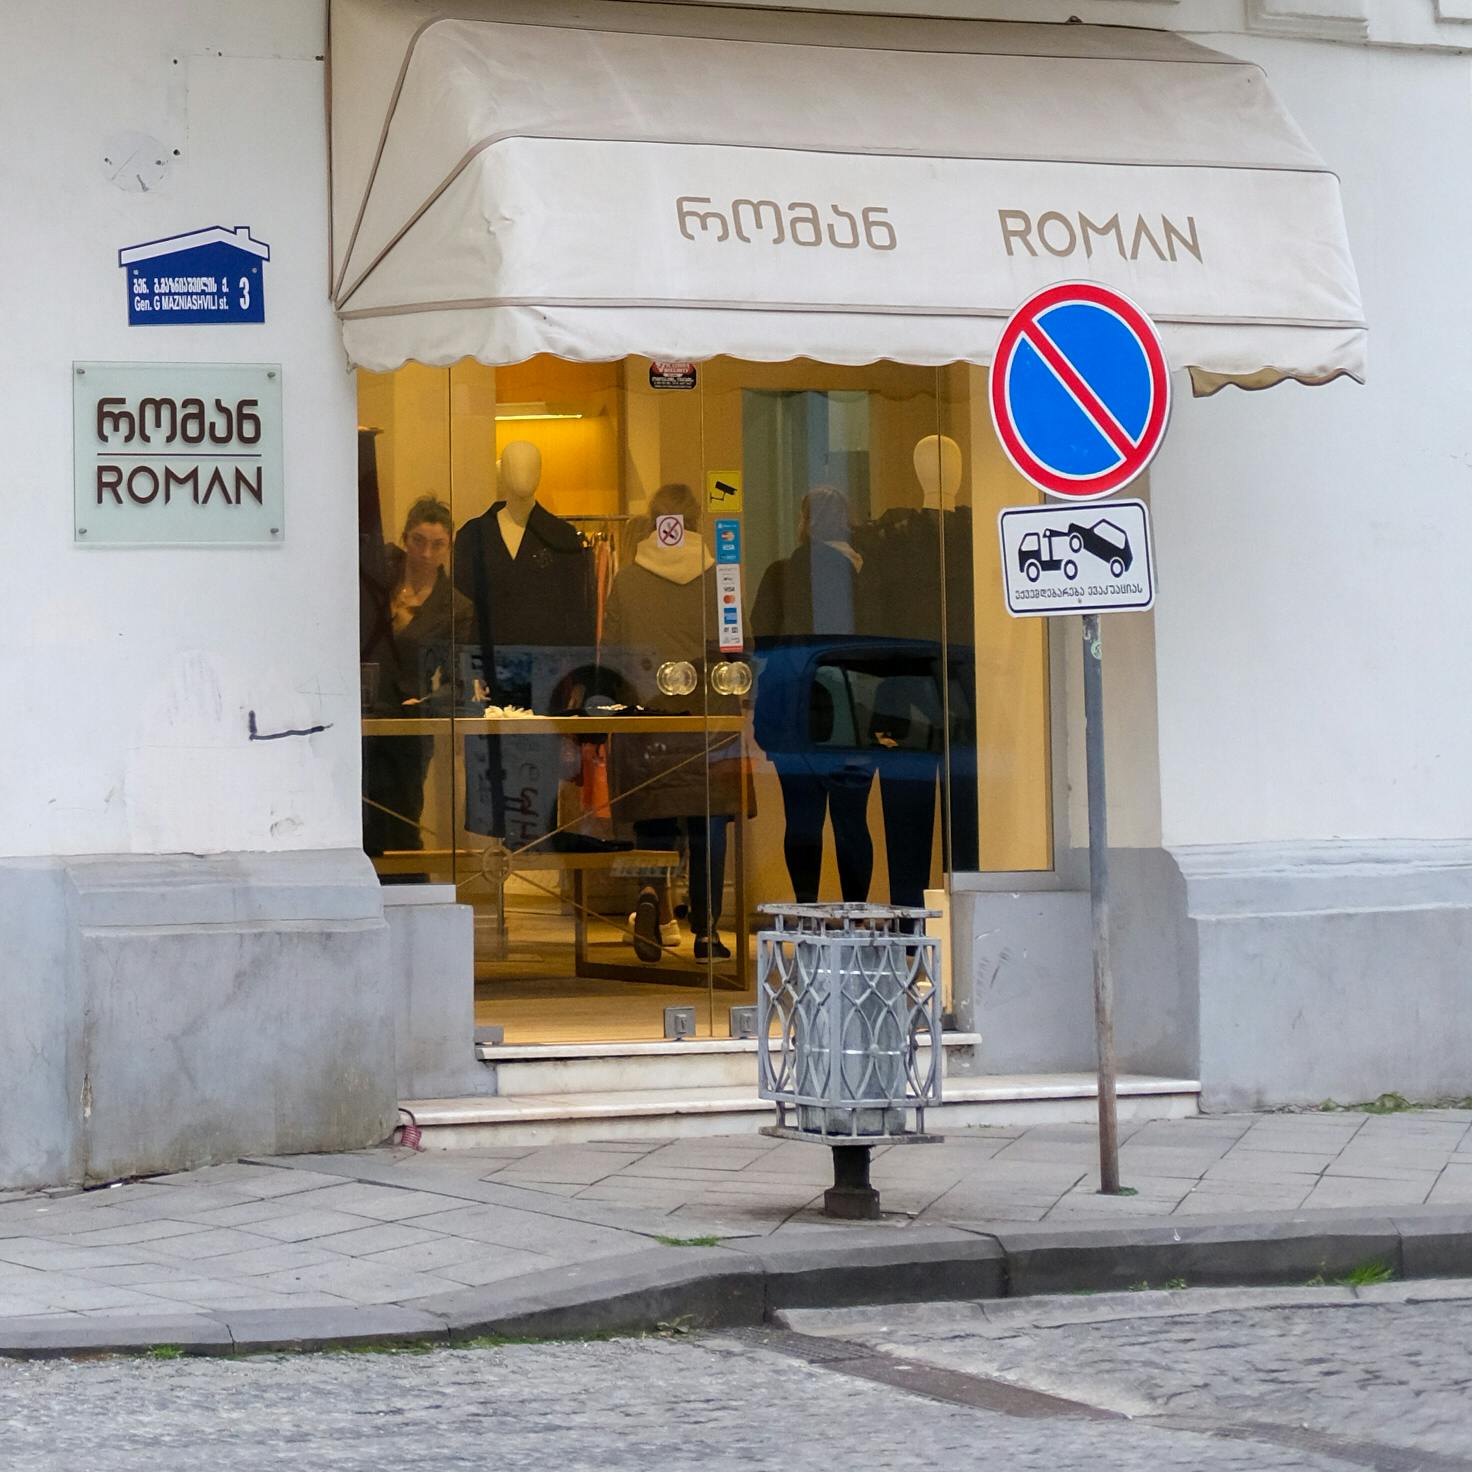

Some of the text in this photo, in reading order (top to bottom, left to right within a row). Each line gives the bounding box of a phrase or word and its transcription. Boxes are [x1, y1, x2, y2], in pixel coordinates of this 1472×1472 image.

[676, 196, 897, 250] რომან
[998, 209, 1204, 264] ROMAN
[134, 296, 152, 311] Gen.
[161, 295, 218, 310] MAZNIASHVILI
[219, 297, 229, 310] st.
[239, 277, 250, 309] 3
[97, 397, 261, 444] რომან
[97, 465, 263, 505] ROMAN
